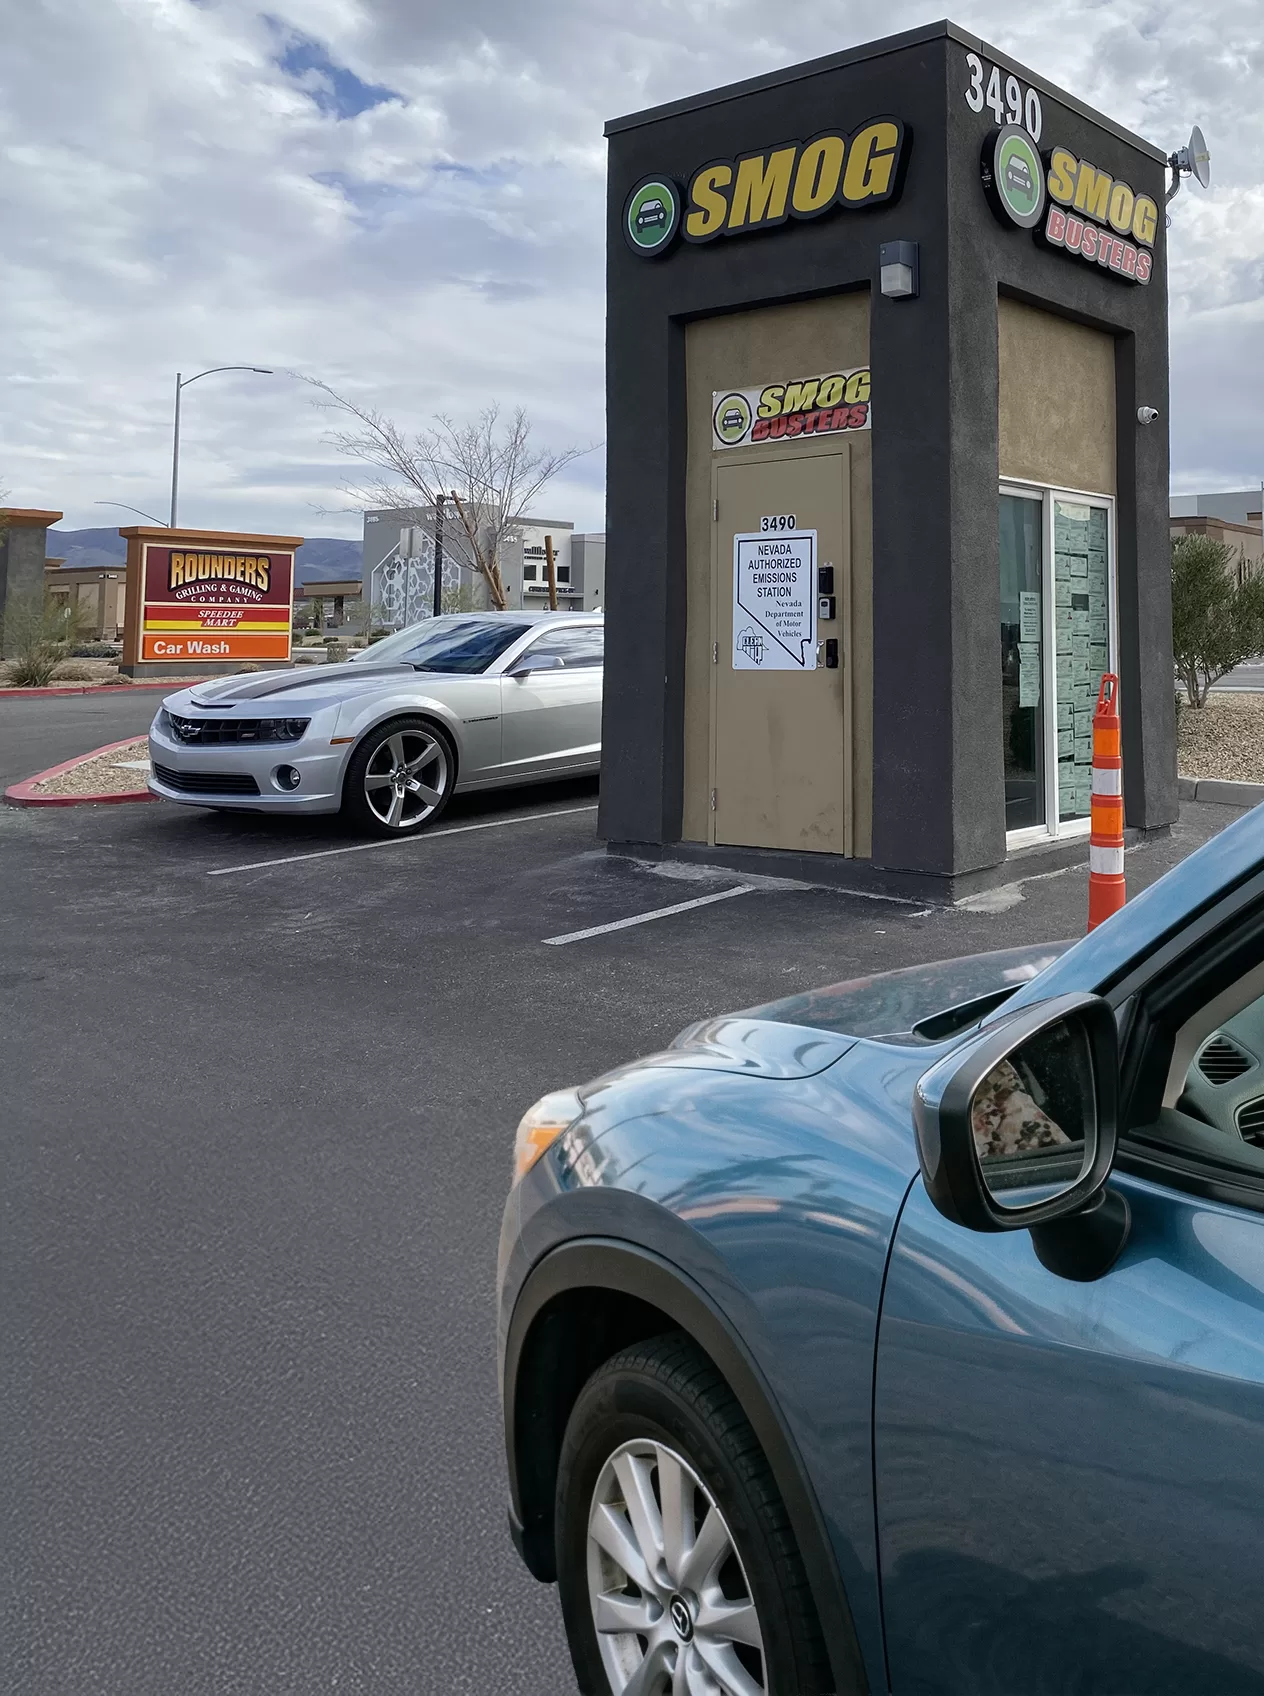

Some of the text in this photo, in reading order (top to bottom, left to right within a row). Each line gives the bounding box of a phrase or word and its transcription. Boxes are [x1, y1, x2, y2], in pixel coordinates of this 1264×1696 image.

[965, 53, 1042, 143] 3490
[686, 122, 899, 237] SMOG
[1049, 152, 1158, 244] SMOG
[1047, 208, 1152, 282] BUSTERS
[757, 370, 871, 418] SMOG
[751, 404, 869, 441] BUSTERS
[761, 514, 796, 532] 3490
[757, 543, 793, 556] NEVADA
[747, 557, 802, 570] AUTHORIZED
[169, 551, 270, 592] ROUNDERS
[752, 571, 798, 584] EMISSIONS
[175, 583, 262, 601] GRILLING & GAMING
[190, 595, 249, 603] COMPANY
[756, 586, 792, 598] STATION
[775, 600, 802, 608] Nevada
[198, 610, 244, 618] SPEEDEE
[765, 610, 804, 619] Department
[775, 620, 802, 628] of Motor
[777, 629, 802, 638] Vehicles
[153, 640, 230, 655] Car Wash
